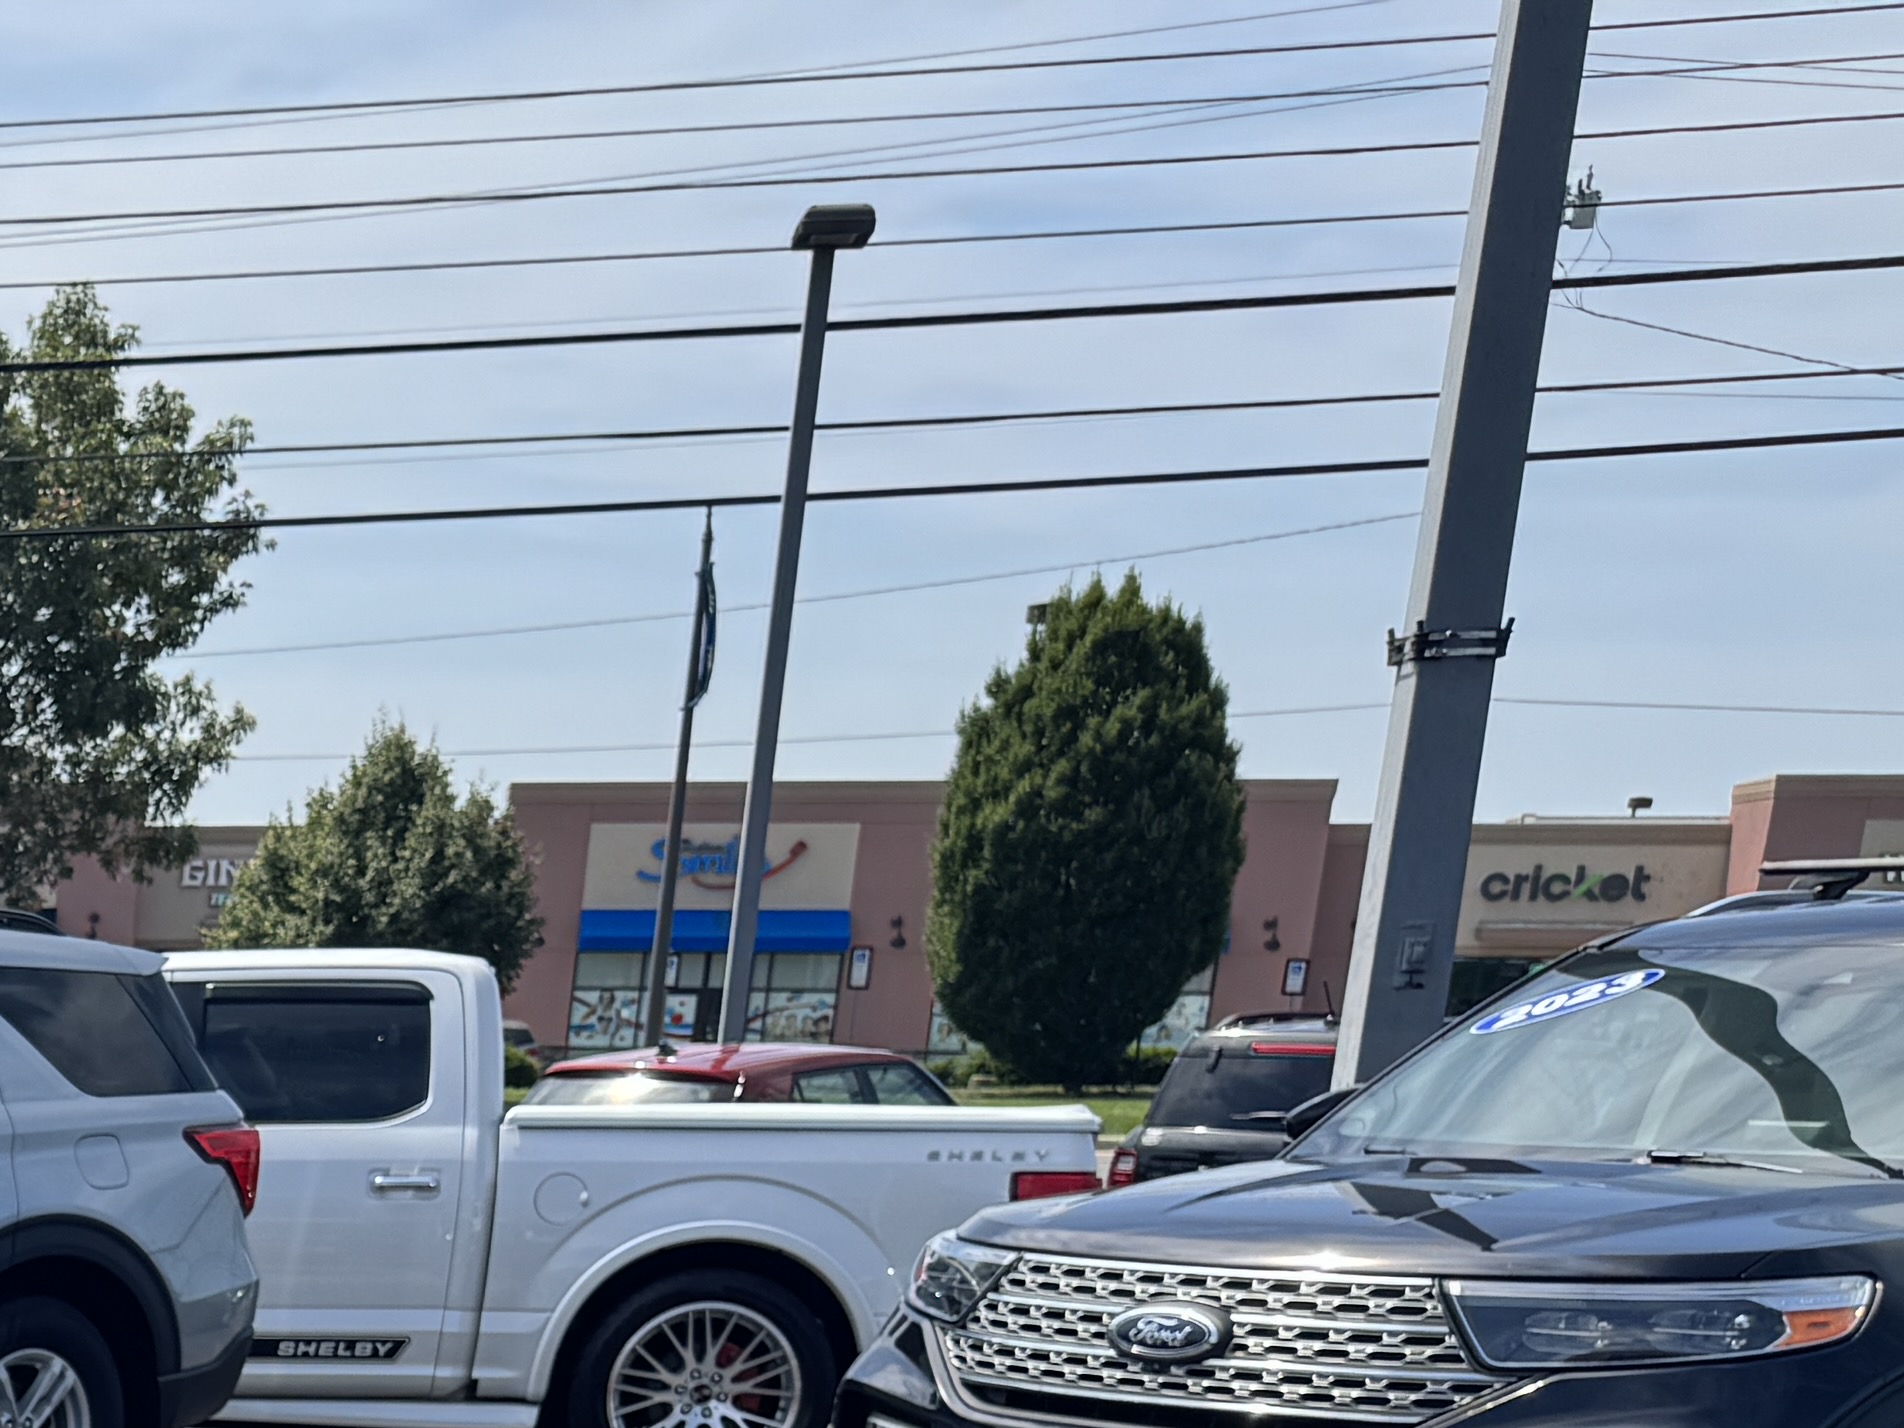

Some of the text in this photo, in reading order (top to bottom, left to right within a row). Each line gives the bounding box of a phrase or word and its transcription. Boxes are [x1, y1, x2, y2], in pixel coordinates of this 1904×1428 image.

[1480, 864, 1651, 902] cricket
[926, 1150, 1049, 1162] SHELBY
[1128, 1317, 1192, 1347] Ford
[277, 1340, 395, 1357] SHELBY
